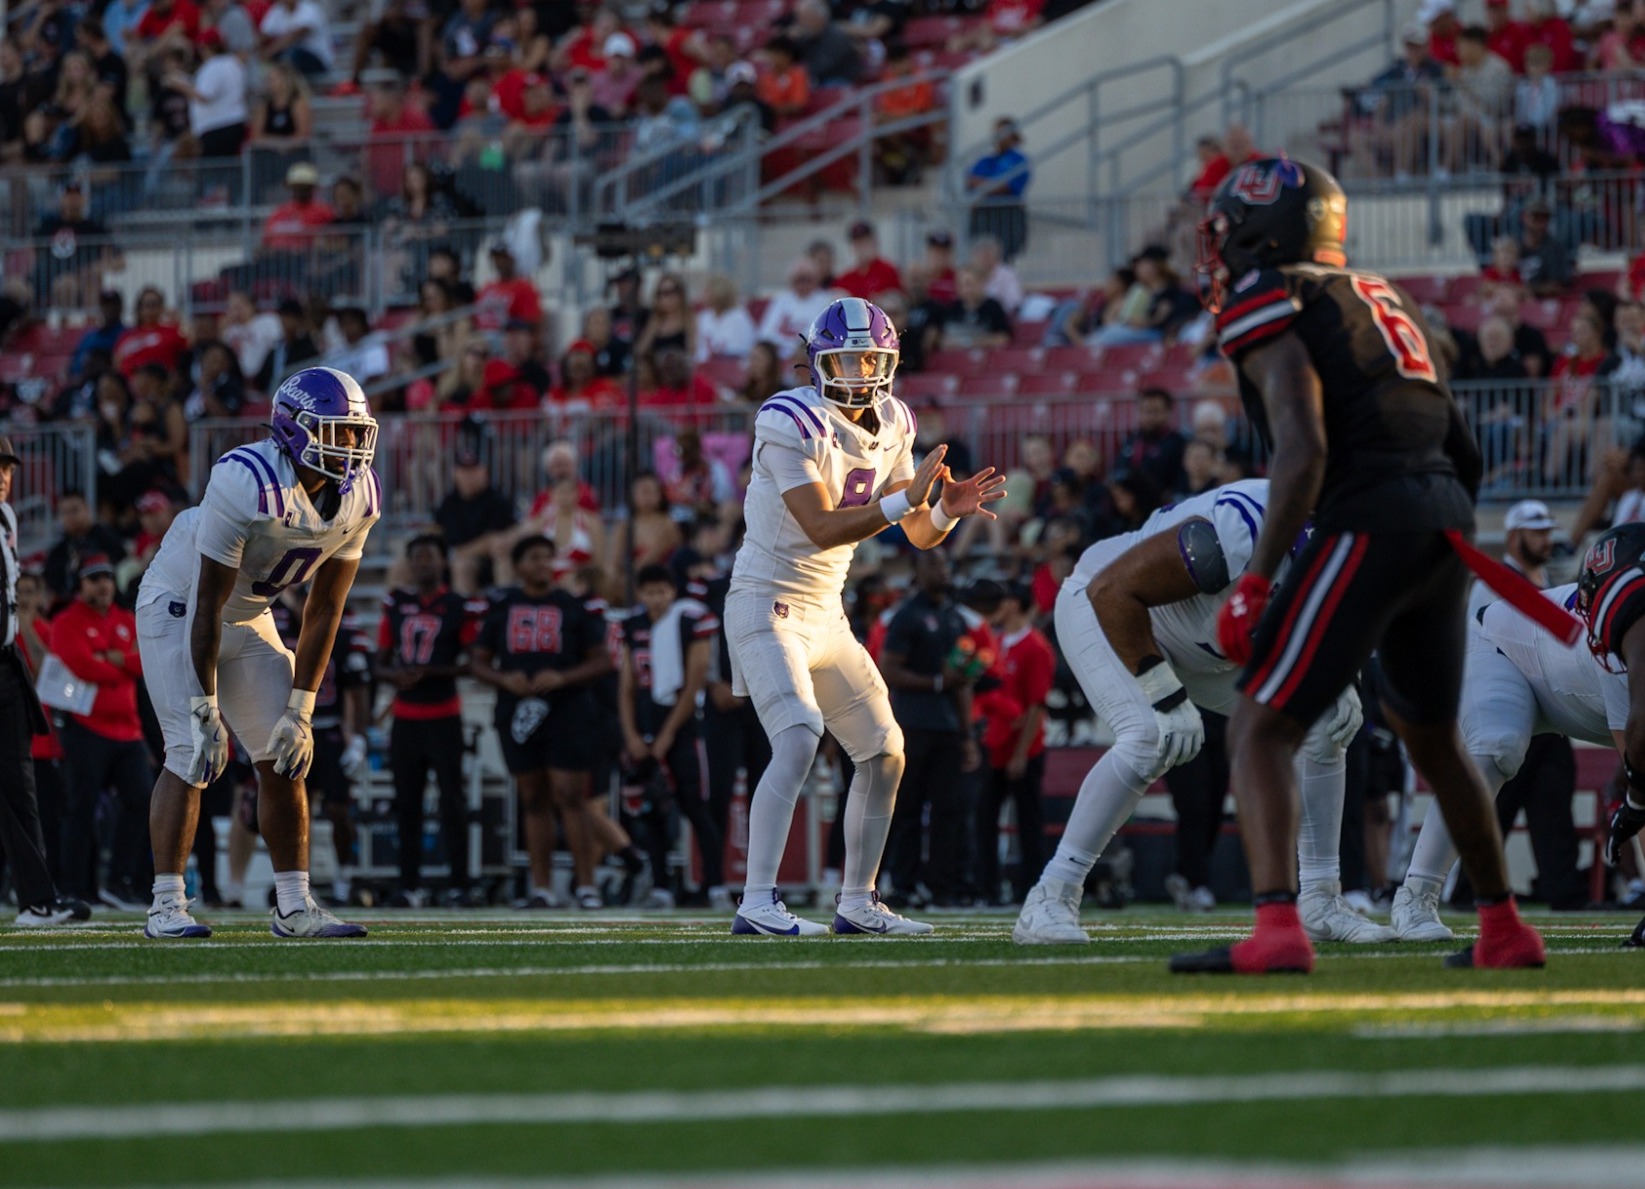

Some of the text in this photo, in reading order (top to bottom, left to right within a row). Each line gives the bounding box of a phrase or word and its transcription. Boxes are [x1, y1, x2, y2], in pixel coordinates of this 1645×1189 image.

[1230, 163, 1283, 205] LU
[1350, 273, 1438, 383] 6
[281, 376, 317, 410] Bears
[251, 547, 323, 597] 0
[401, 614, 442, 664] 17
[507, 604, 563, 653] 68
